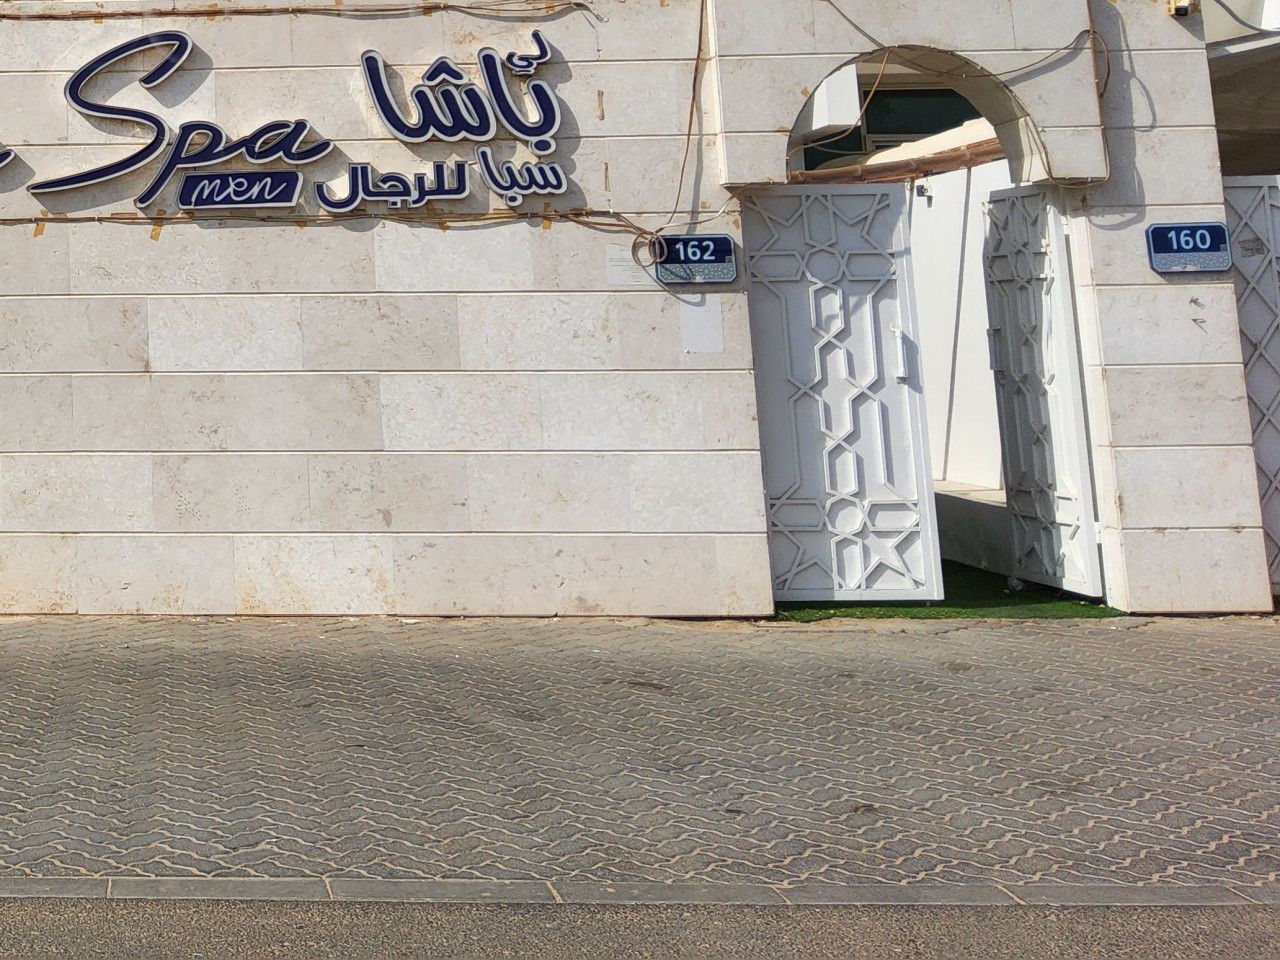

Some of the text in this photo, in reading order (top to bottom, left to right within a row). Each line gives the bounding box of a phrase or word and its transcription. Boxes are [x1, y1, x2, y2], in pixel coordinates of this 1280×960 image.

[25, 30, 334, 209] Spa
[361, 47, 562, 156] باشا
[191, 176, 288, 207] men
[313, 143, 568, 213] سبا للرجال
[675, 240, 716, 260] 162
[1167, 229, 1211, 250] 160
